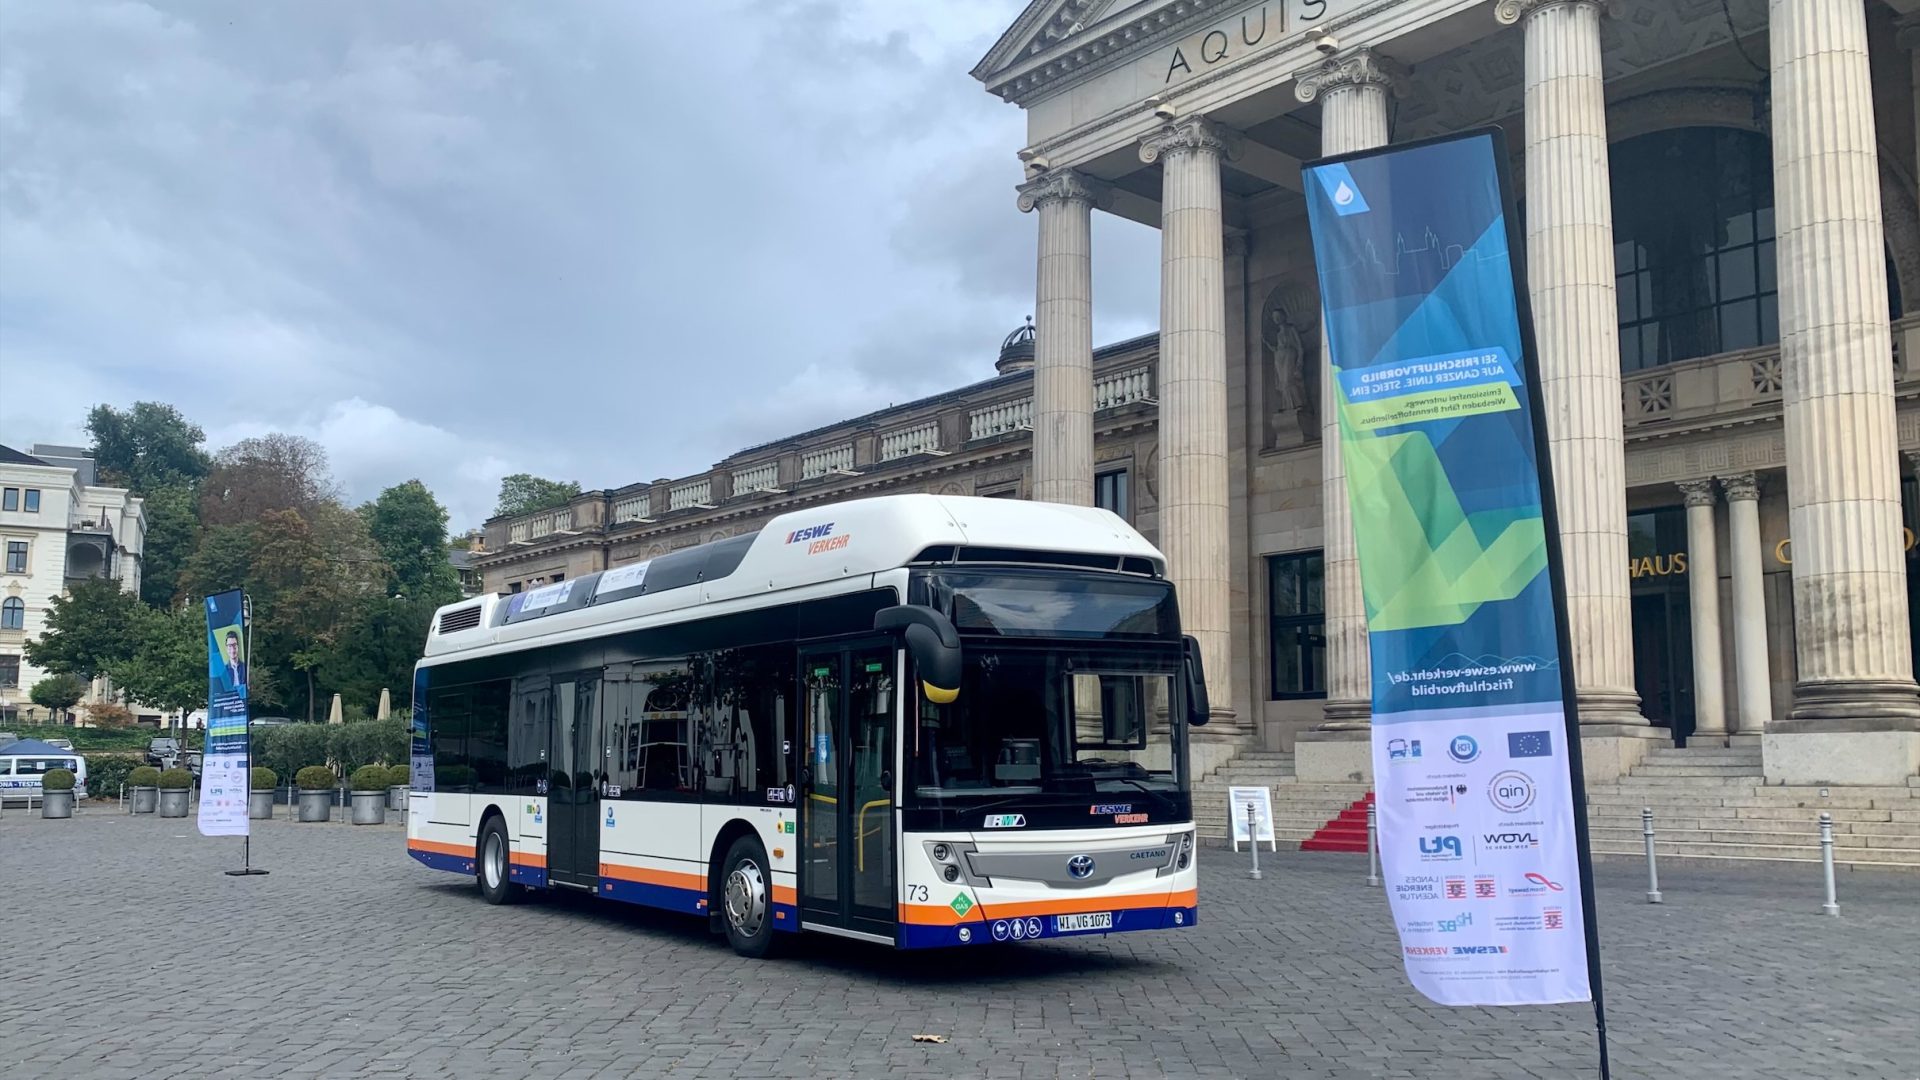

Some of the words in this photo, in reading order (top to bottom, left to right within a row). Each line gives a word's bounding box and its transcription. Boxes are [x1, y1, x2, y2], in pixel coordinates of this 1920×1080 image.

[1165, 0, 1327, 83] AQUIS
[792, 522, 835, 543] ESWE
[807, 534, 850, 555] VERKEHR
[1097, 804, 1131, 814] ESWE
[1114, 813, 1149, 823] VERKEHR
[1130, 850, 1166, 860] CAETANO
[600, 863, 609, 876] 73
[907, 884, 929, 902] 73
[1059, 916, 1070, 929] WI
[1076, 915, 1088, 928] VG
[1090, 913, 1111, 927] 1073
